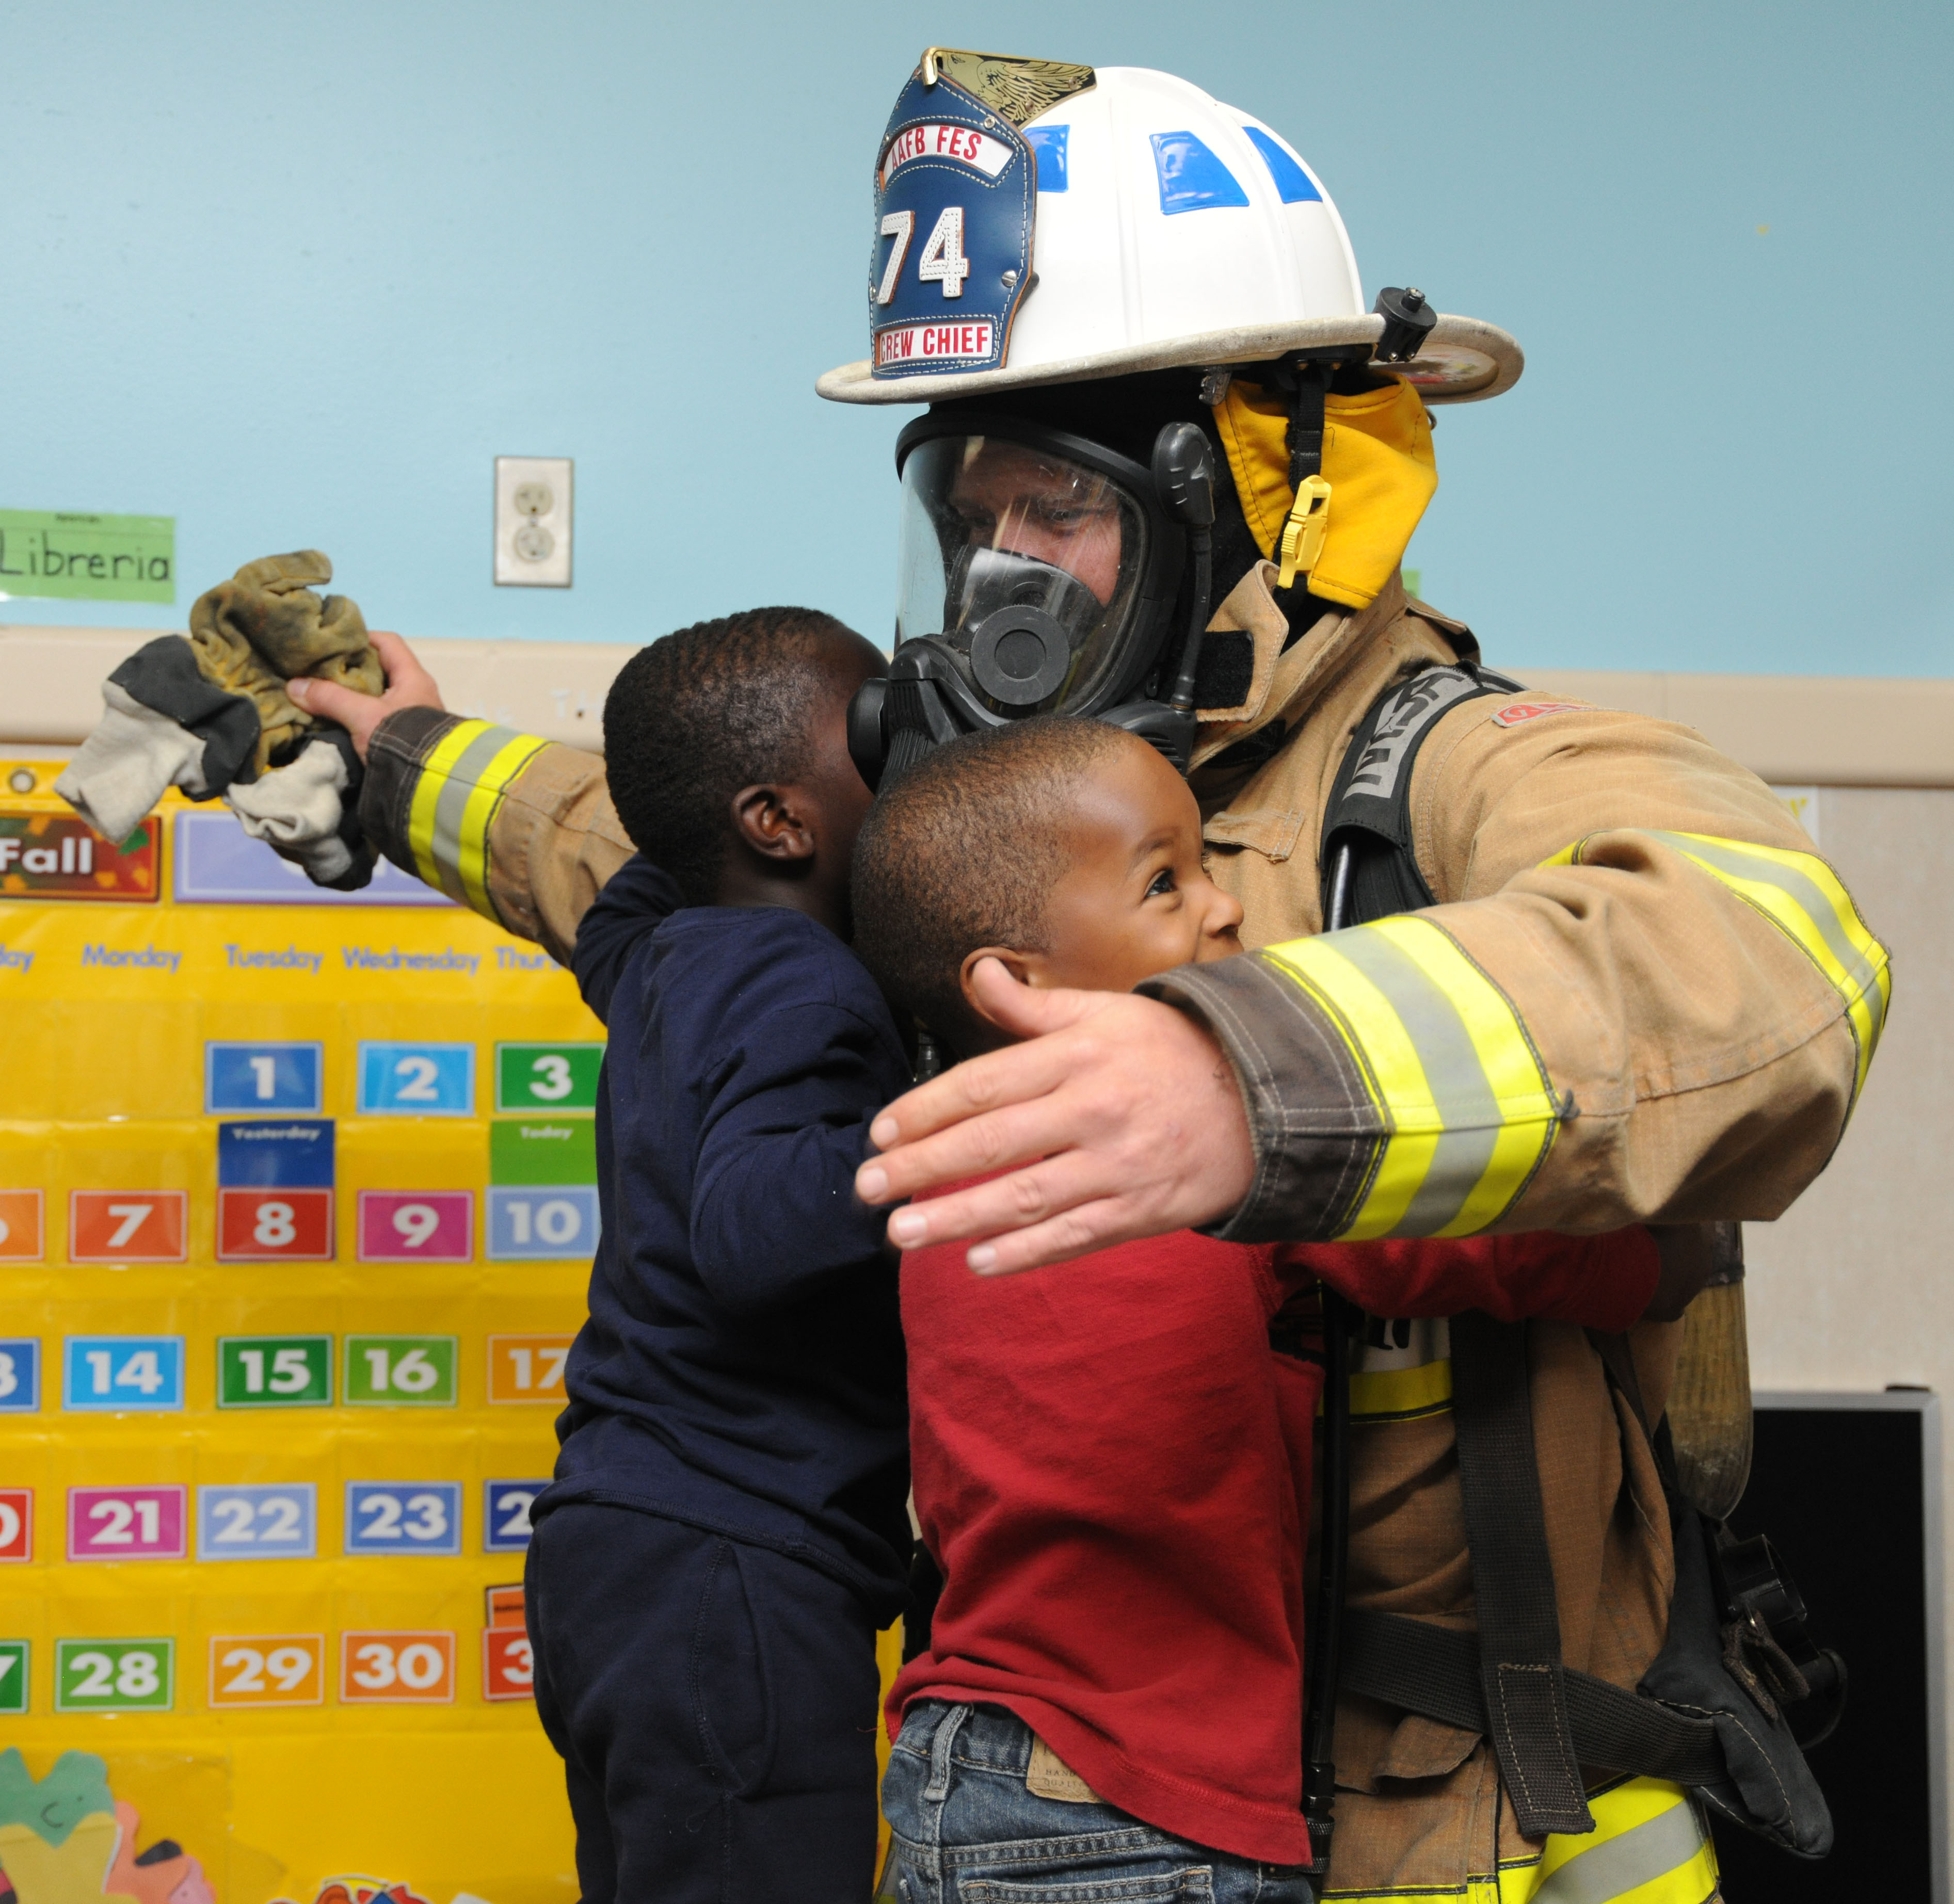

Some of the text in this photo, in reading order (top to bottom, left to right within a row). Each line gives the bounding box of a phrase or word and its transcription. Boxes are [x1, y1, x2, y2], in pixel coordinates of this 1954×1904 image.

[892, 126, 982, 172] AAFB FES
[877, 207, 968, 304] 74
[882, 327, 988, 361] CREW CHIEF
[0, 530, 169, 580] Libreria
[0, 837, 92, 874] Fall
[82, 944, 182, 974] Monday
[225, 944, 323, 974] Tuesday
[342, 946, 481, 975] Wednesday
[249, 1056, 573, 1100] 1 2 3
[107, 1200, 582, 1247] 7 8 9 10
[86, 1351, 163, 1394] 14
[239, 1349, 311, 1393] 15
[365, 1349, 438, 1393] 16
[89, 1492, 533, 1544] 21 22 23 2
[69, 1652, 159, 1697] 28
[221, 1647, 312, 1692] 29
[353, 1644, 444, 1689] 30
[502, 1639, 534, 1684] 3
